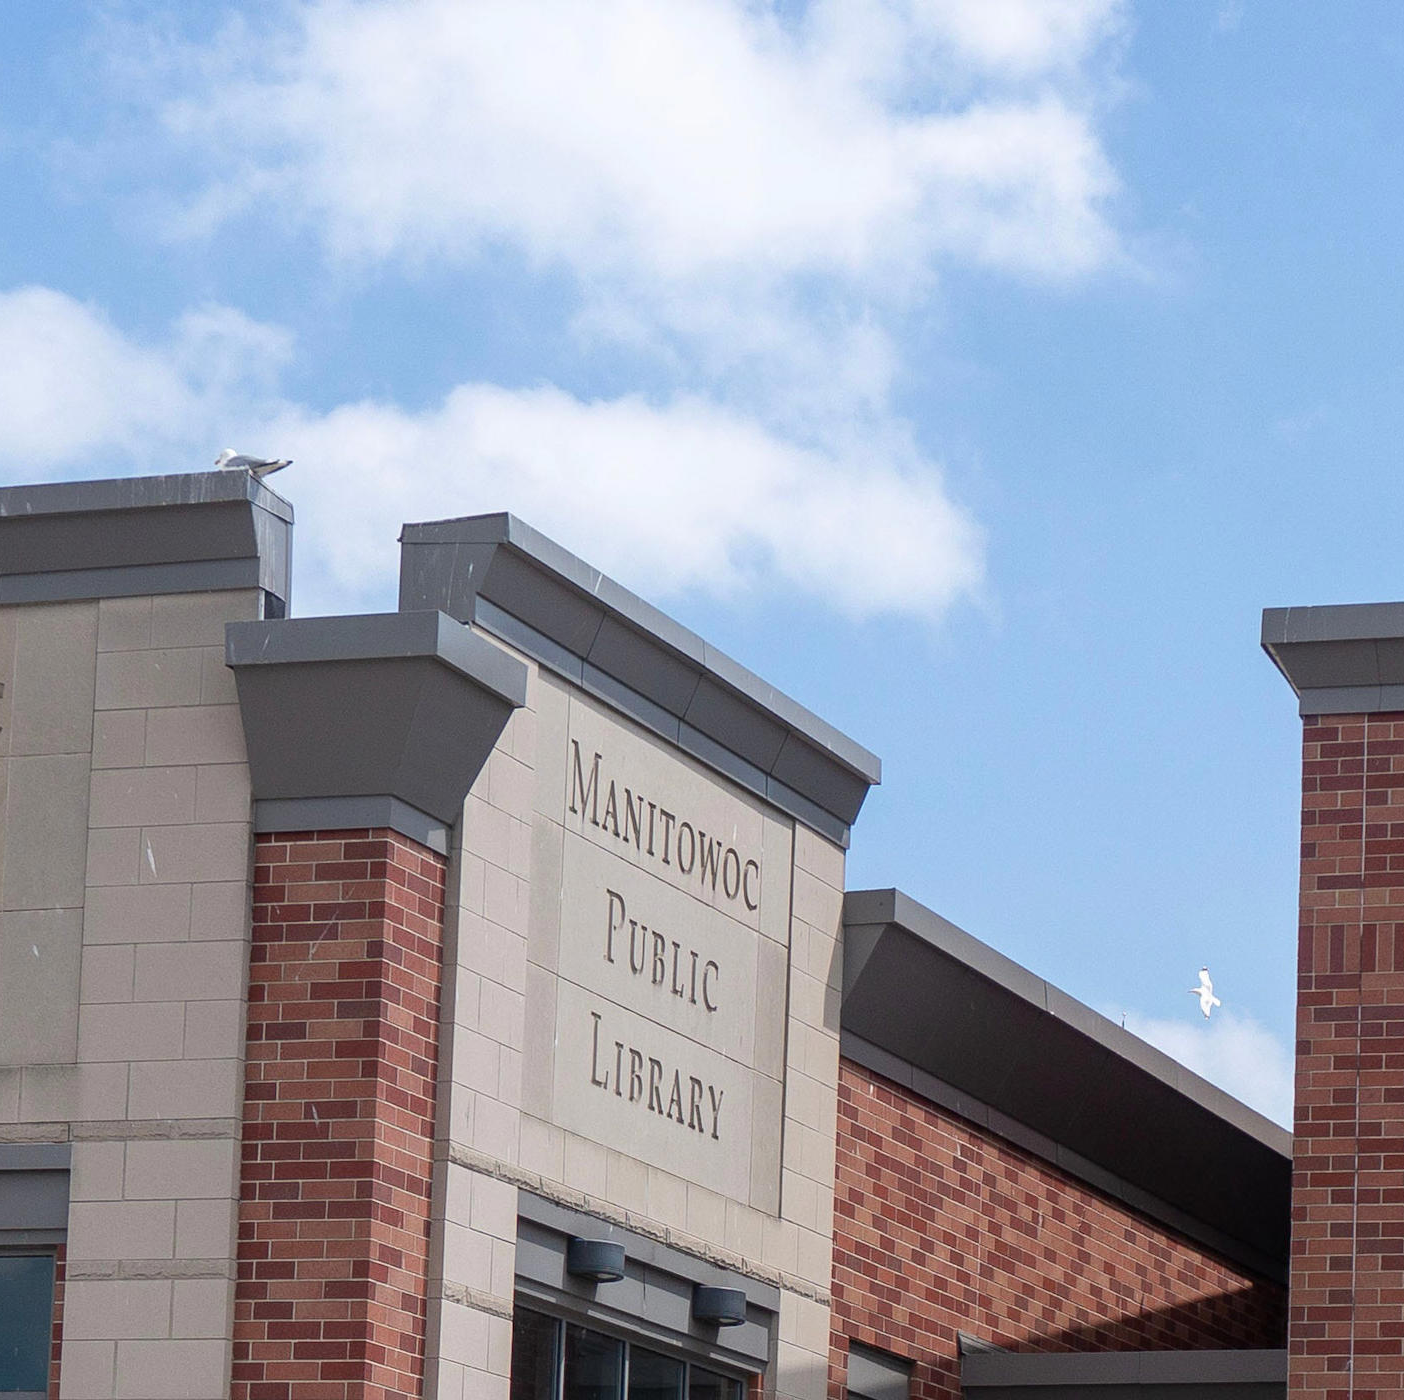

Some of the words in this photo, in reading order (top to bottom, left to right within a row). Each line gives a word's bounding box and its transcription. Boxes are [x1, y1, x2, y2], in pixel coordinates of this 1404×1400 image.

[568, 738, 760, 912] MANITOWOC
[604, 888, 720, 1013] PUBLIC
[591, 1011, 724, 1141] LIBRARY
